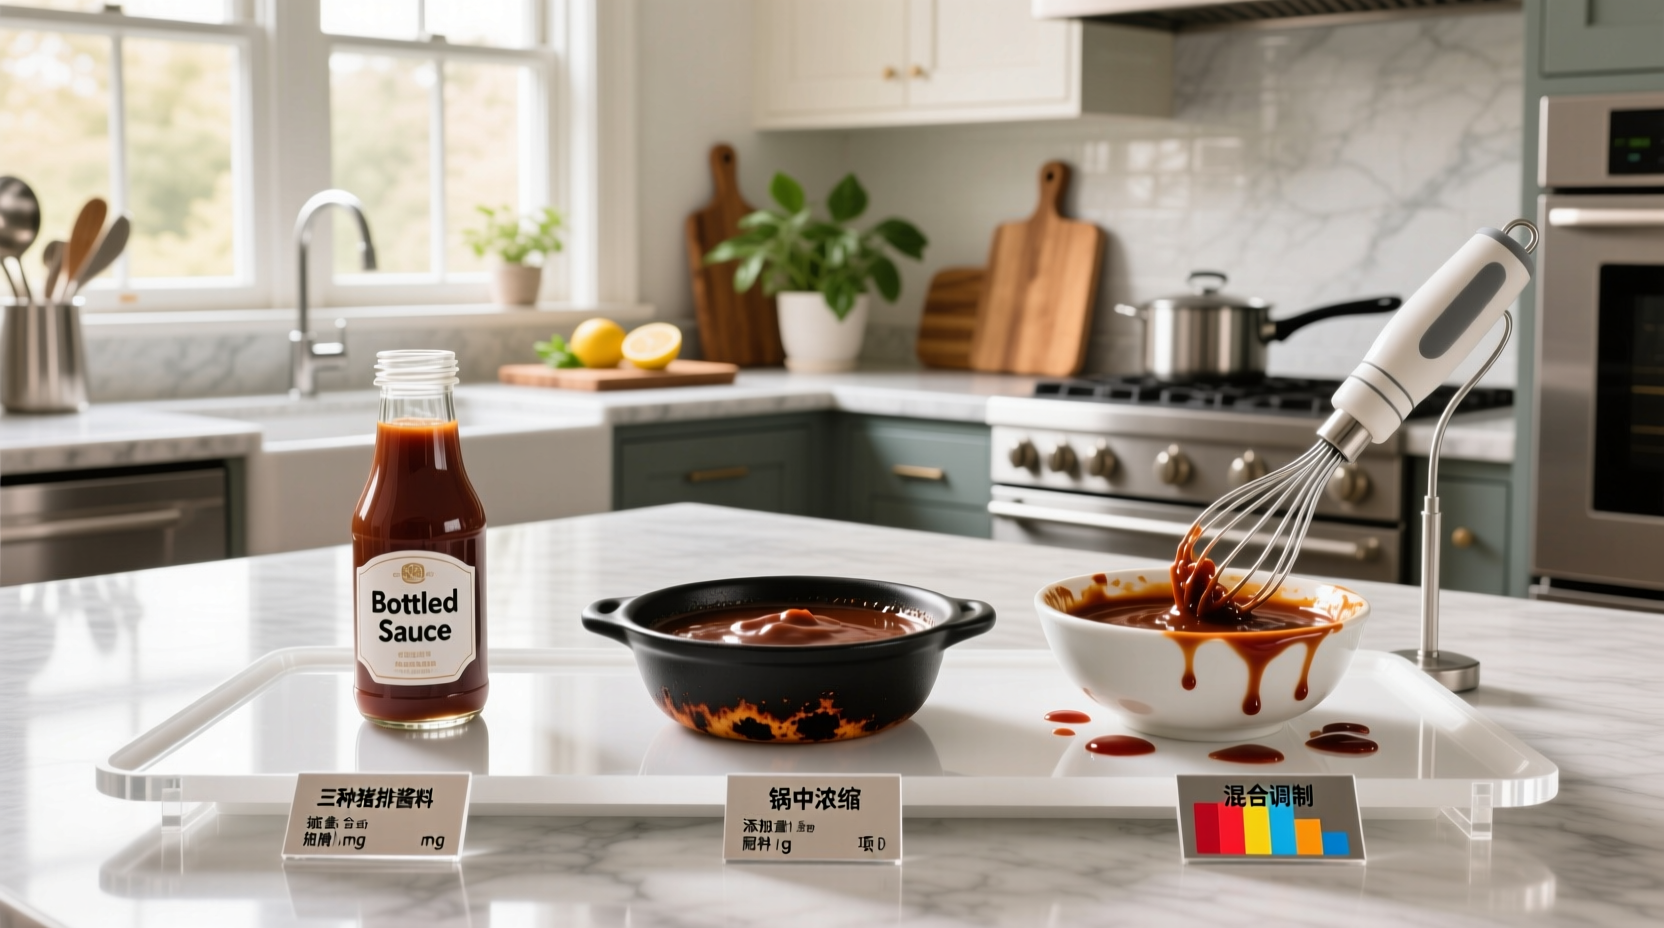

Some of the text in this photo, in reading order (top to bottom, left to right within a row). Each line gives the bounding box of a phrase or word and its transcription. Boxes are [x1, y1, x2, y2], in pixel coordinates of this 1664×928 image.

[372, 588, 458, 615] Bottled
[378, 618, 452, 643] Sauce
[317, 787, 434, 809] 三种猪排酱料
[769, 786, 862, 811] 锅中浓缩
[1223, 783, 1314, 808] 混合调制
[420, 835, 445, 850] mg
